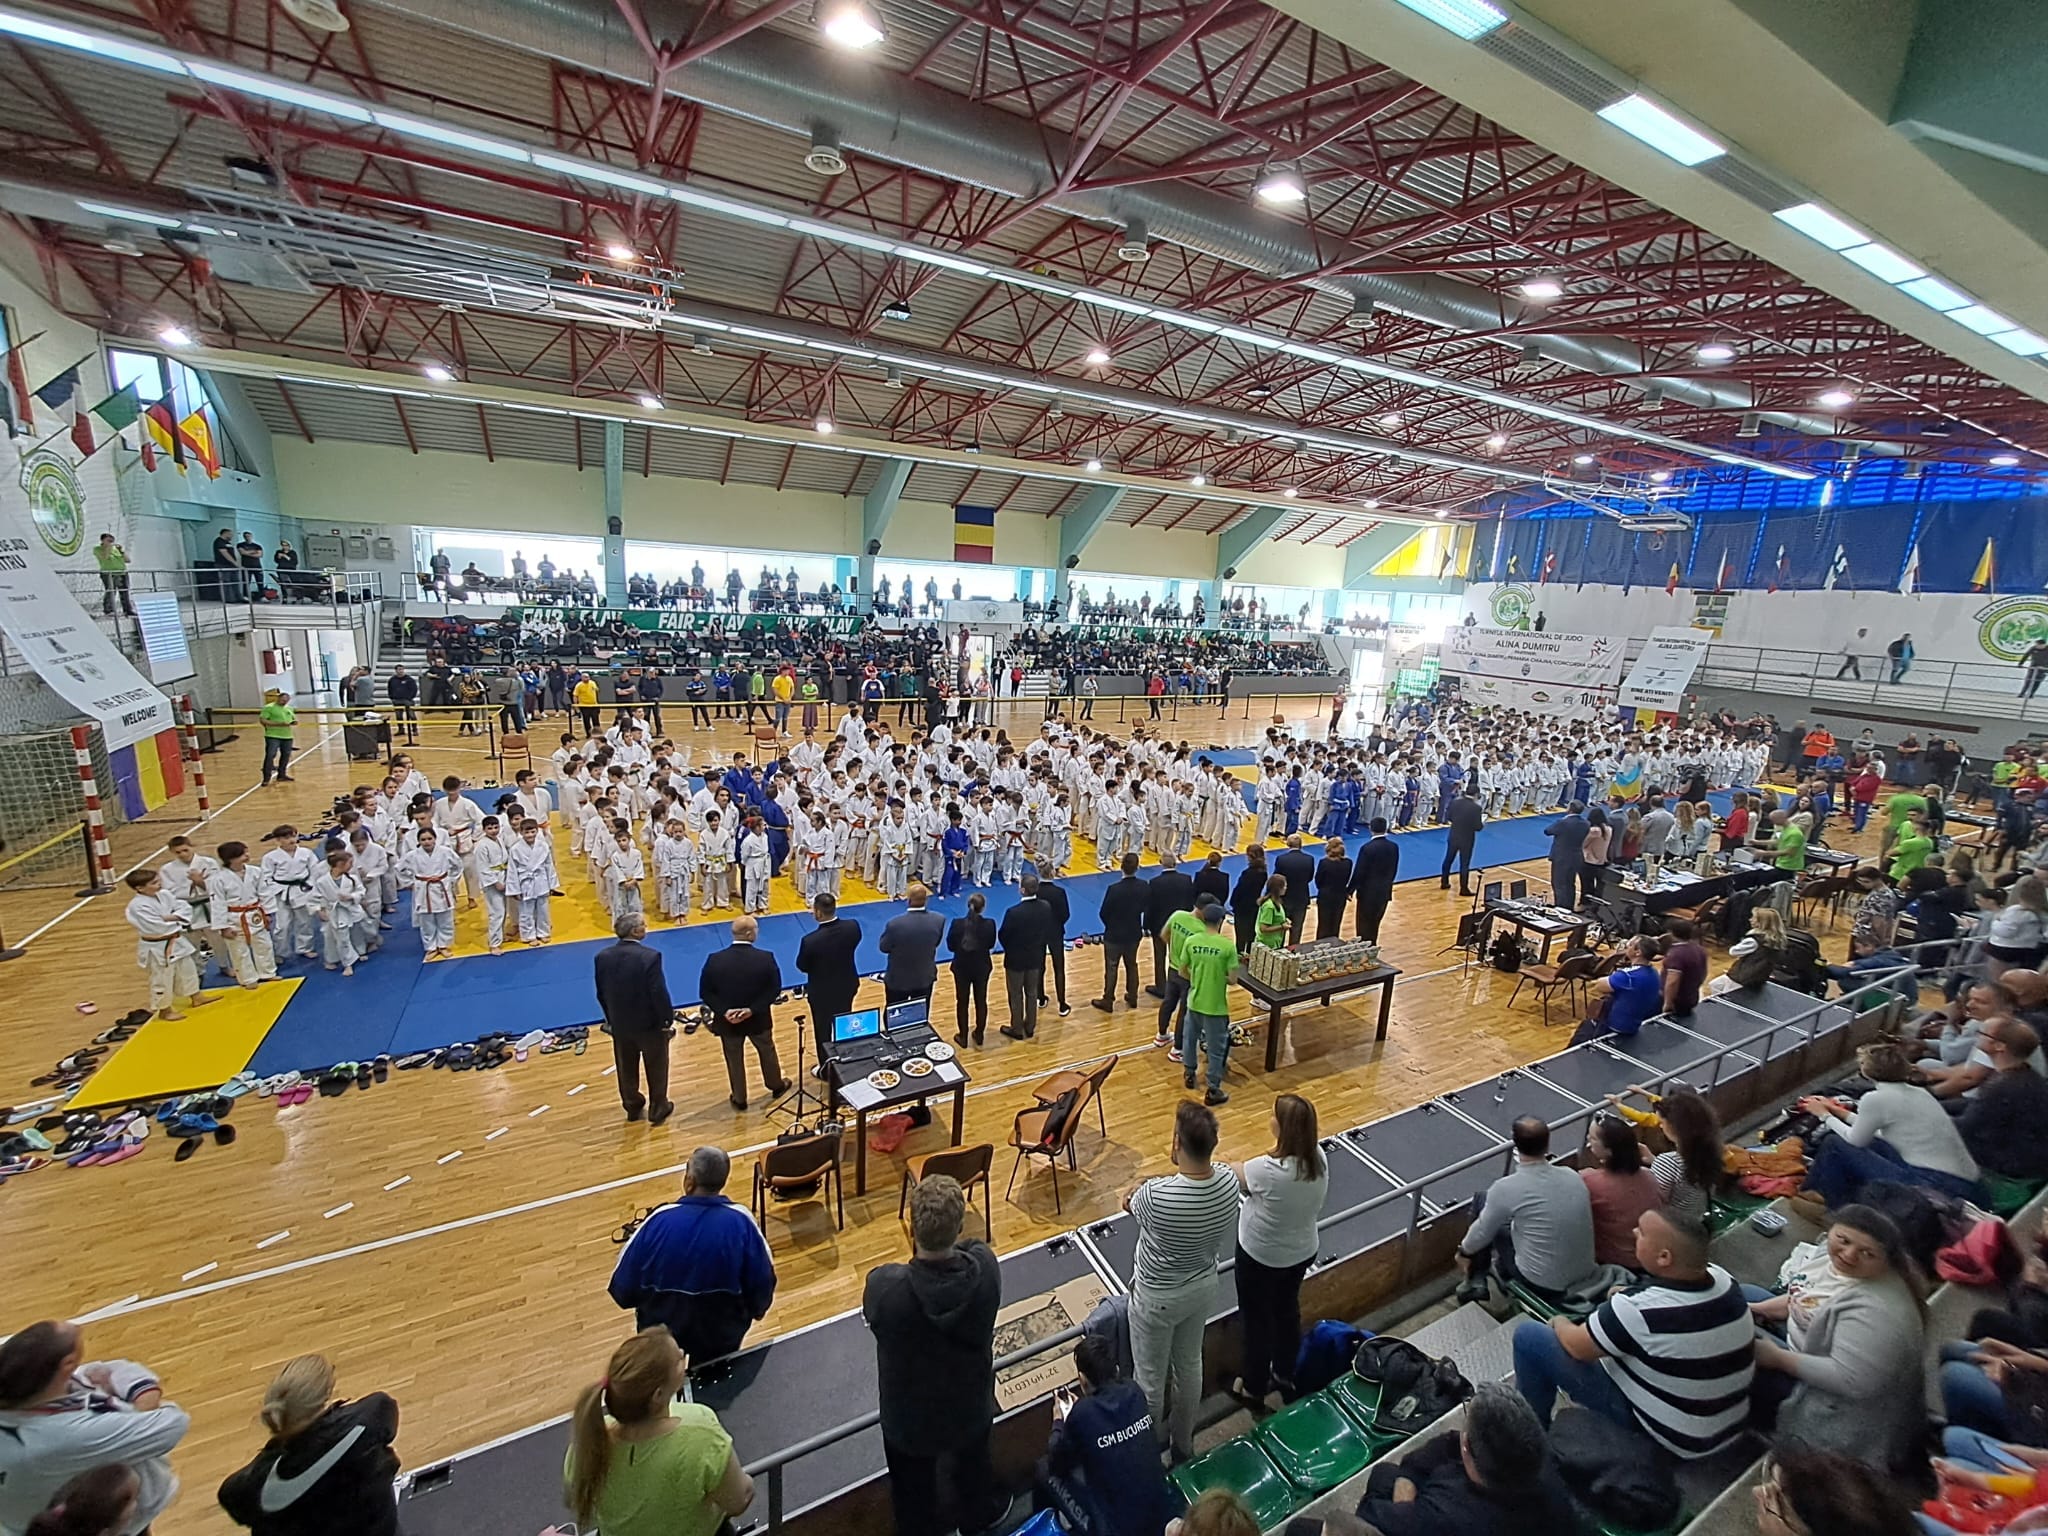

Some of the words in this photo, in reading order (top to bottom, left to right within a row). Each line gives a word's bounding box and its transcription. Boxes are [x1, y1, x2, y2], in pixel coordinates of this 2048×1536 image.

[658, 612, 695, 629] FAIR
[821, 617, 854, 632] PLAY
[1078, 626, 1101, 639] FAR
[1179, 630, 1202, 642] PAY
[1504, 630, 1553, 641] INTERNATIONAL
[1564, 635, 1583, 643] JUDO
[1495, 640, 1520, 649] ALINA
[1522, 641, 1560, 653] DUMITRU
[1192, 945, 1221, 956] STAFF
[1002, 1386, 1015, 1397] TV
[1014, 1378, 1032, 1392] LED
[1097, 1433, 1117, 1448] CSM
